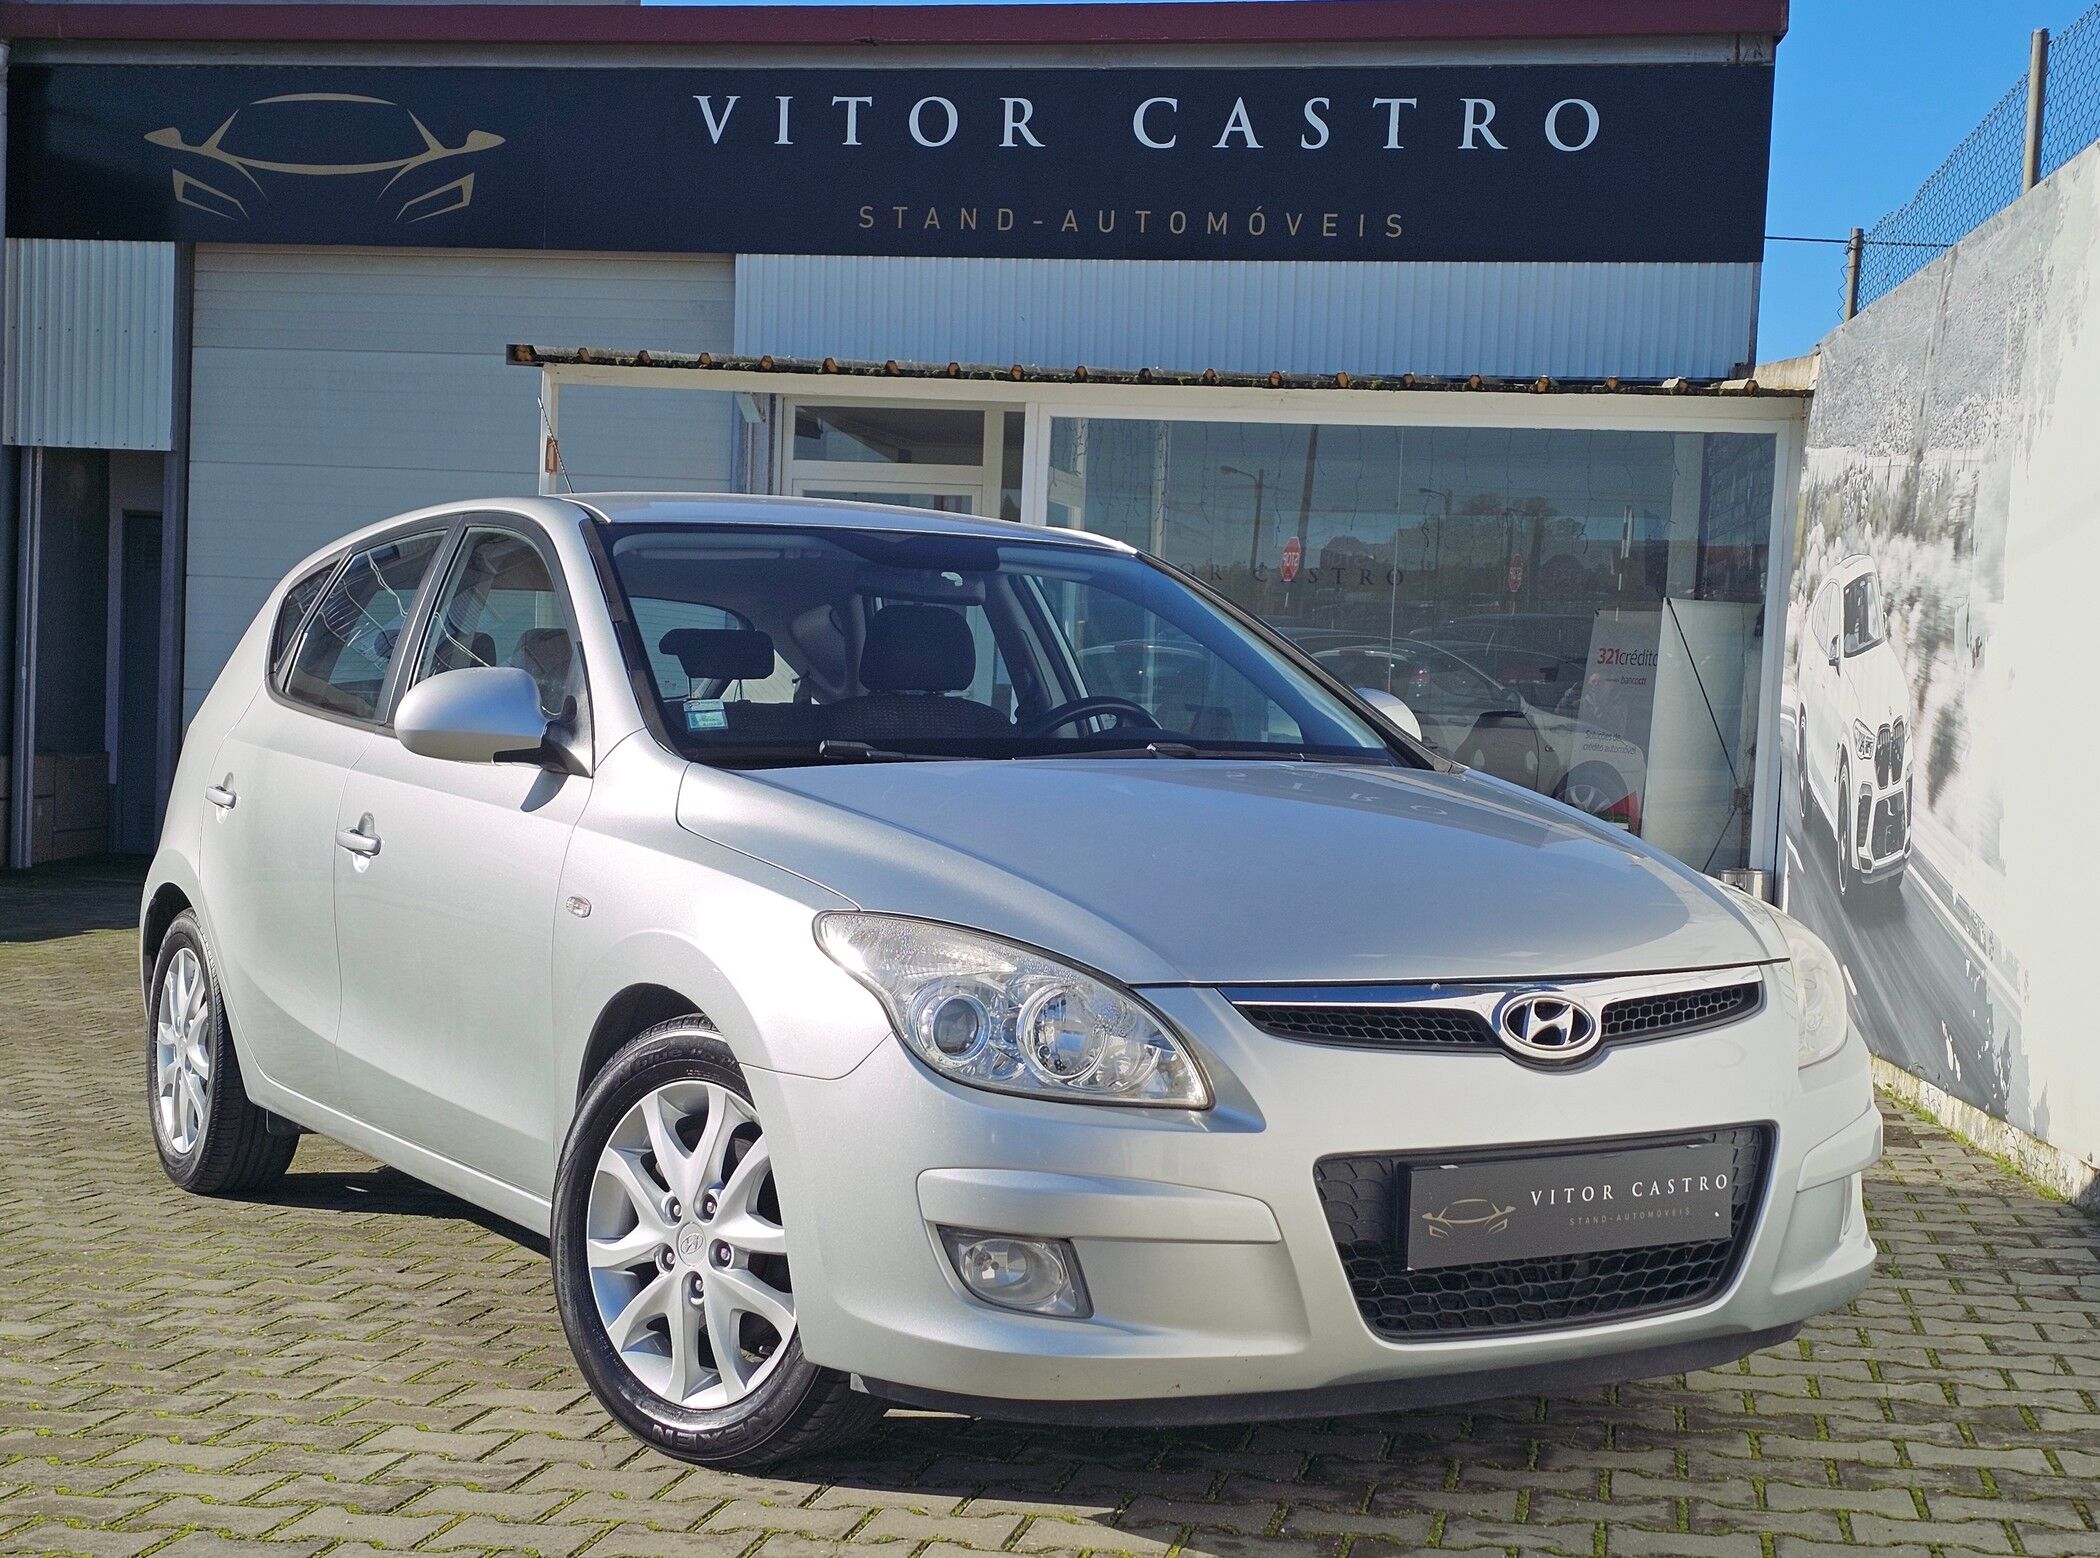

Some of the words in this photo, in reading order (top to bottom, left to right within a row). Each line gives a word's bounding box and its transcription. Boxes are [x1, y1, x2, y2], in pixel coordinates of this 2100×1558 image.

[692, 95, 1046, 149] VITOR
[1132, 96, 1600, 152] CASTRO
[858, 204, 1404, 239] STAND-AUTOMÓVEIS
[1530, 1184, 1614, 1207] VITOR
[1631, 1173, 1729, 1198] CASTRO
